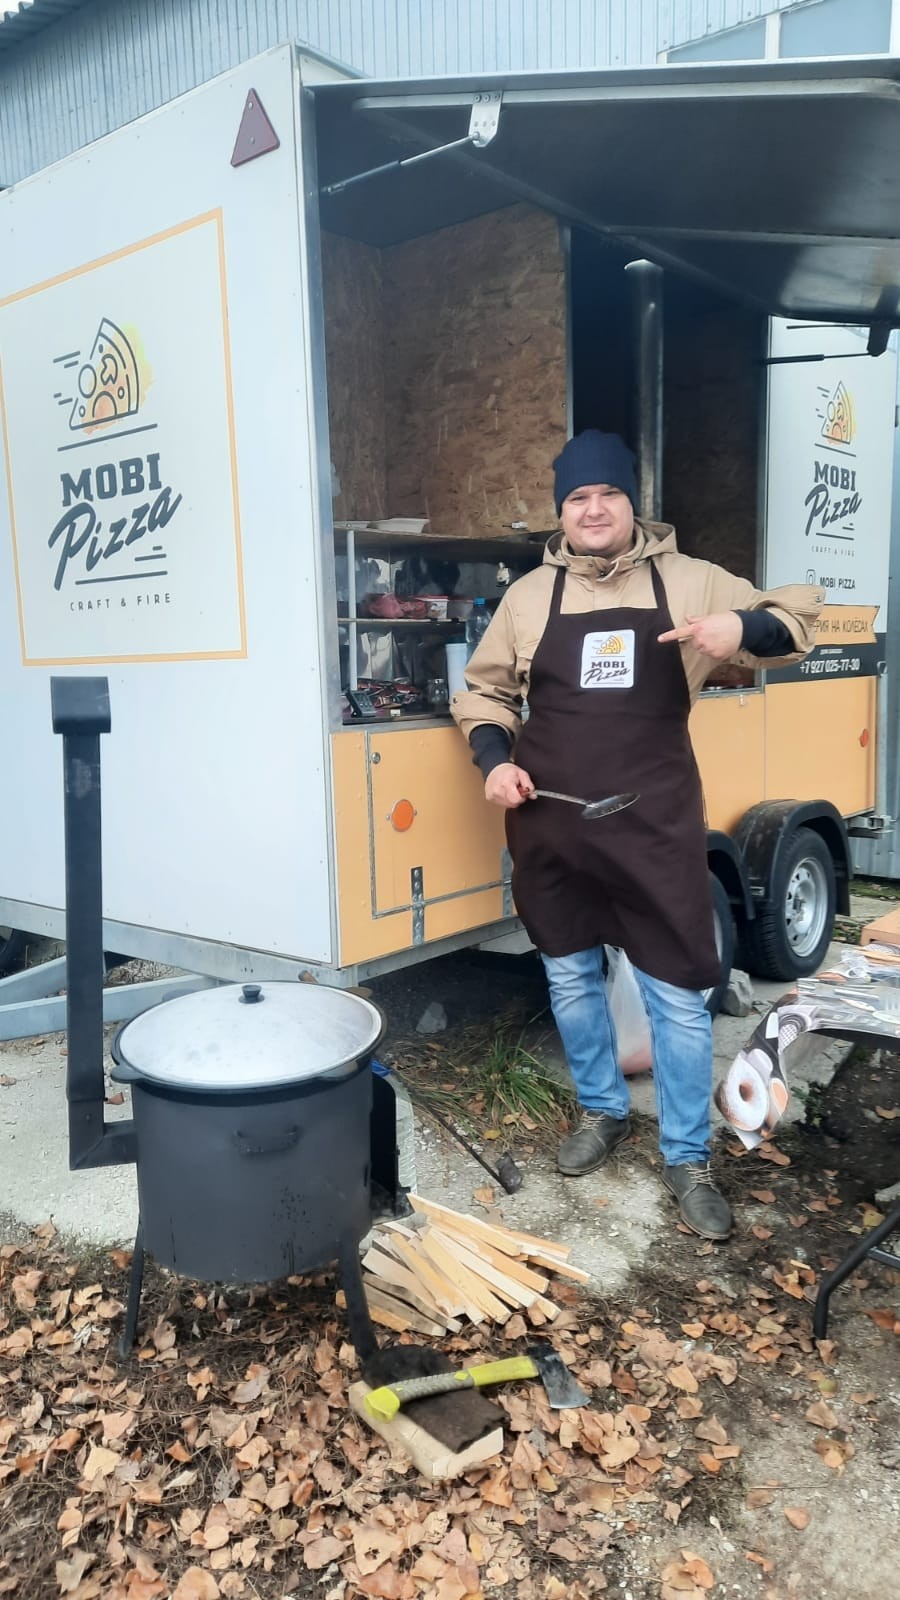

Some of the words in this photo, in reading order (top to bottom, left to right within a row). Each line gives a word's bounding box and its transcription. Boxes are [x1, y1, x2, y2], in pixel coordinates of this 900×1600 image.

[60, 453, 162, 507] MOBI
[814, 460, 856, 492] MOBI
[804, 483, 862, 537] Pizza
[48, 486, 183, 591] Pizza
[70, 598, 110, 611] CRAFT
[120, 597, 126, 607] &
[137, 593, 171, 605] FIRE
[584, 668, 631, 685] Pizza
